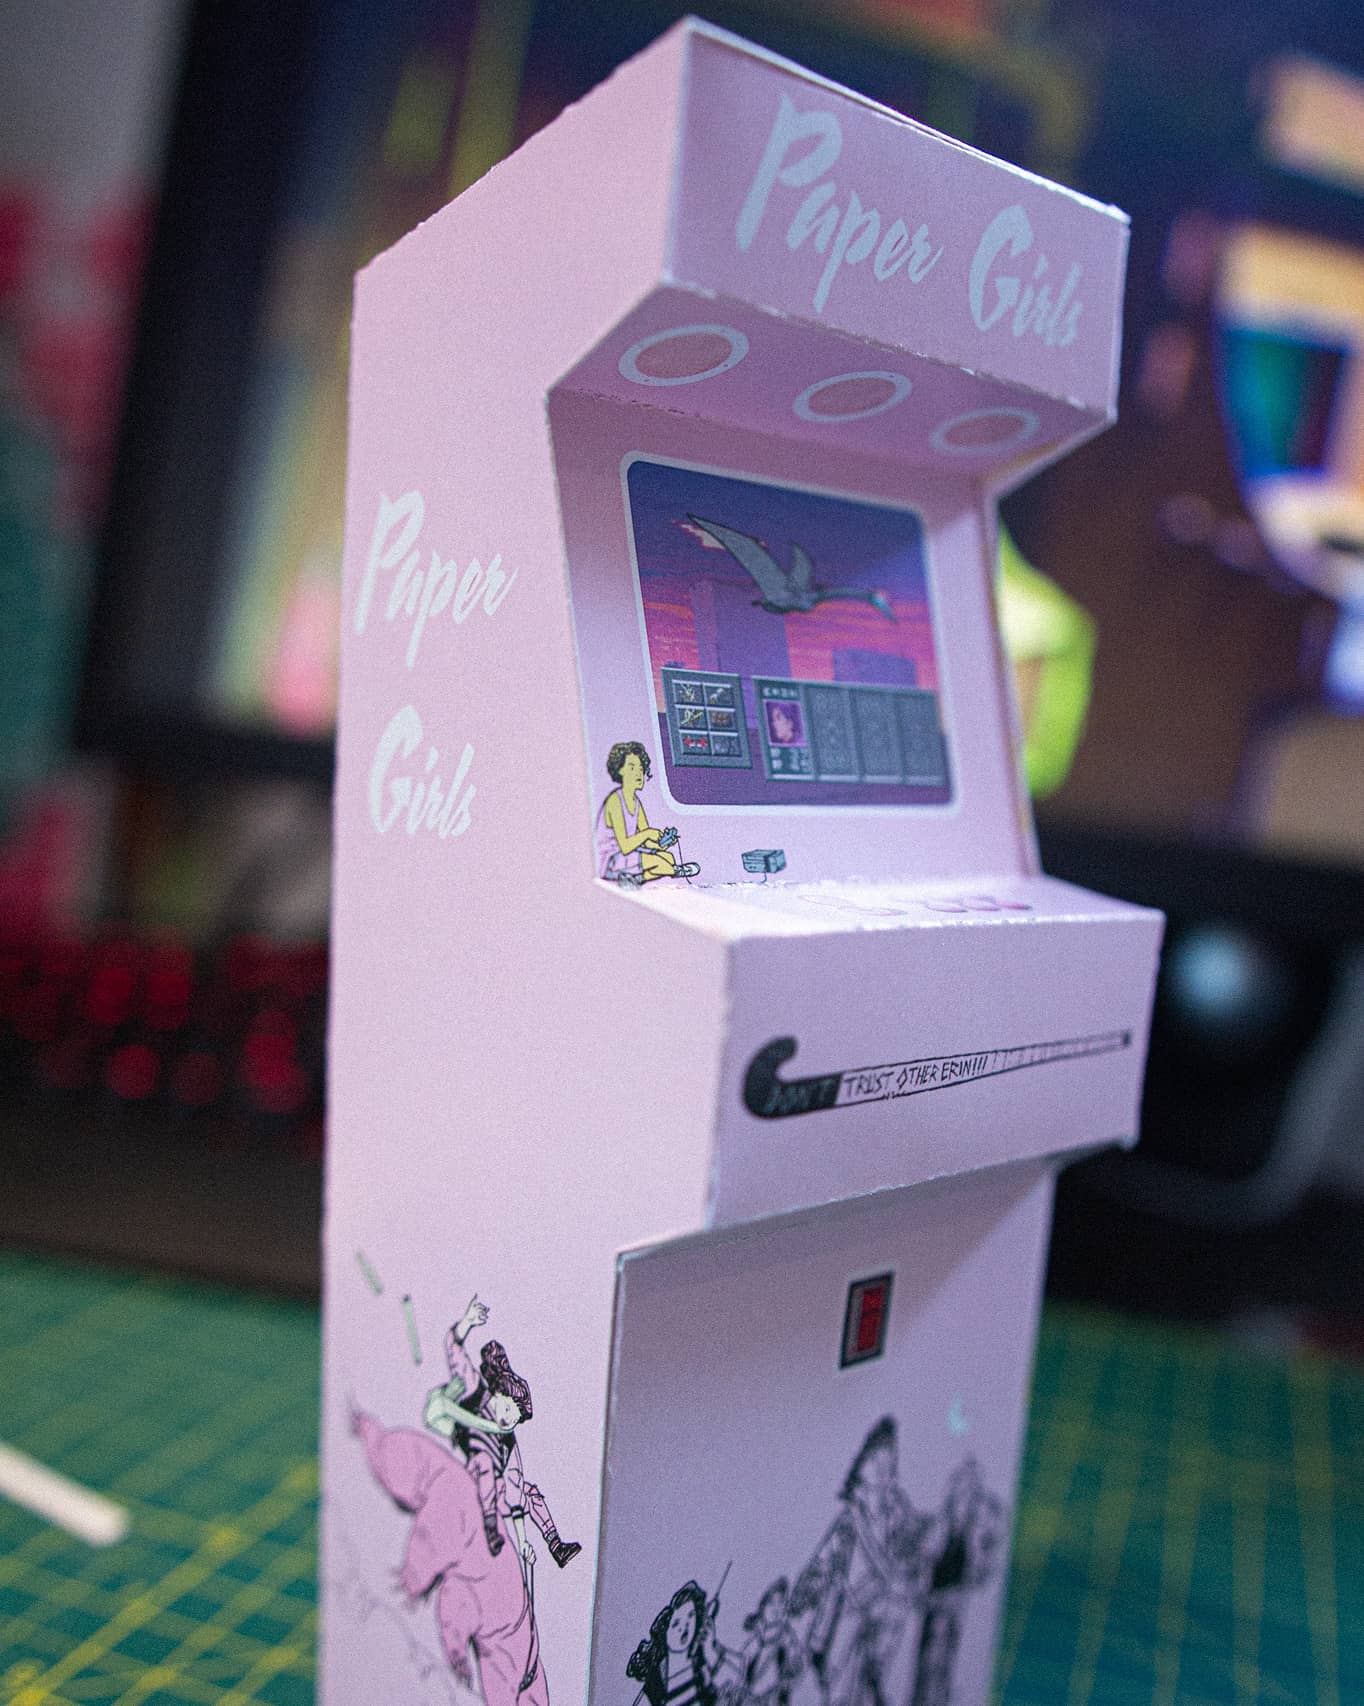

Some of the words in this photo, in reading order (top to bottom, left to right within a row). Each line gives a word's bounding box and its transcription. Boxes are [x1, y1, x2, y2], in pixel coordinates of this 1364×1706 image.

[736, 94, 943, 313] Paper
[968, 204, 1083, 347] Girls
[353, 489, 519, 671] Paper
[369, 704, 477, 840] Girls
[844, 1071, 894, 1097] TRUST
[896, 1062, 938, 1091] OTHER
